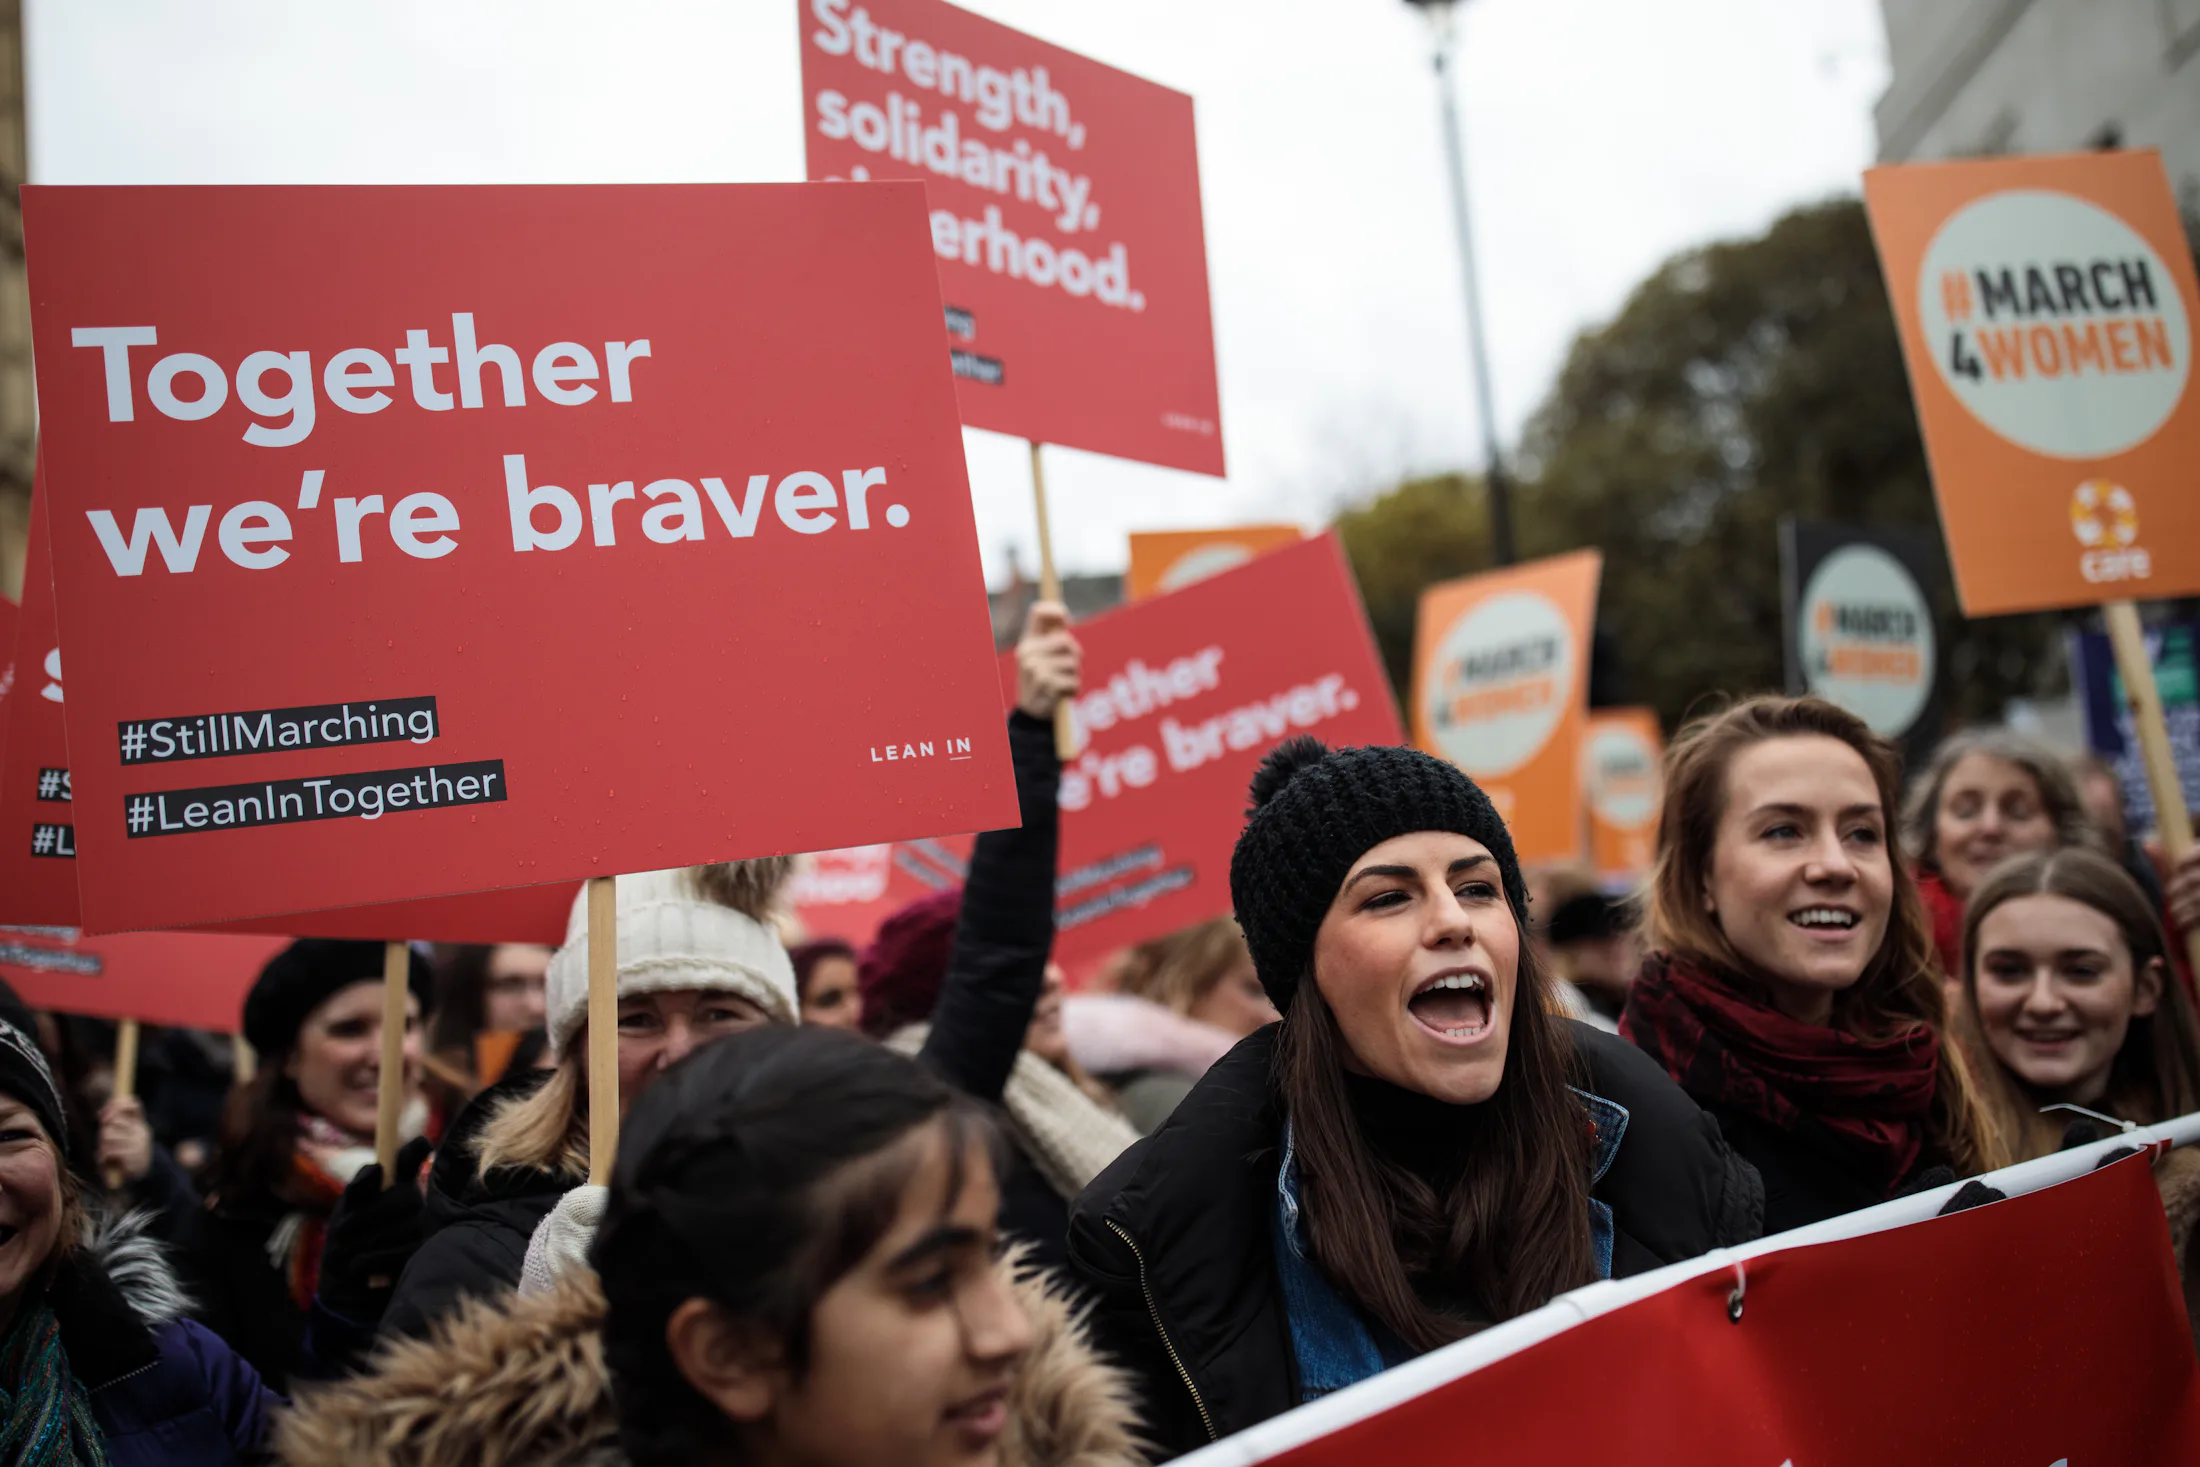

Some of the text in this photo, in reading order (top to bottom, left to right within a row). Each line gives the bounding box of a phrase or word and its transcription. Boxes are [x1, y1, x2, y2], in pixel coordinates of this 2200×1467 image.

[812, 0, 1087, 150] Strength,
[815, 89, 1101, 233] solidarity,
[1941, 254, 2160, 323] #MARCH
[71, 312, 651, 448] Together
[1949, 317, 2175, 385] 4WOMEN
[86, 454, 910, 577] we're braver.
[122, 704, 436, 760] #StillMarching
[870, 737, 972, 762] LEAN IN
[1057, 671, 1361, 811] e're braver.
[128, 767, 497, 834] #LeanInTogether
